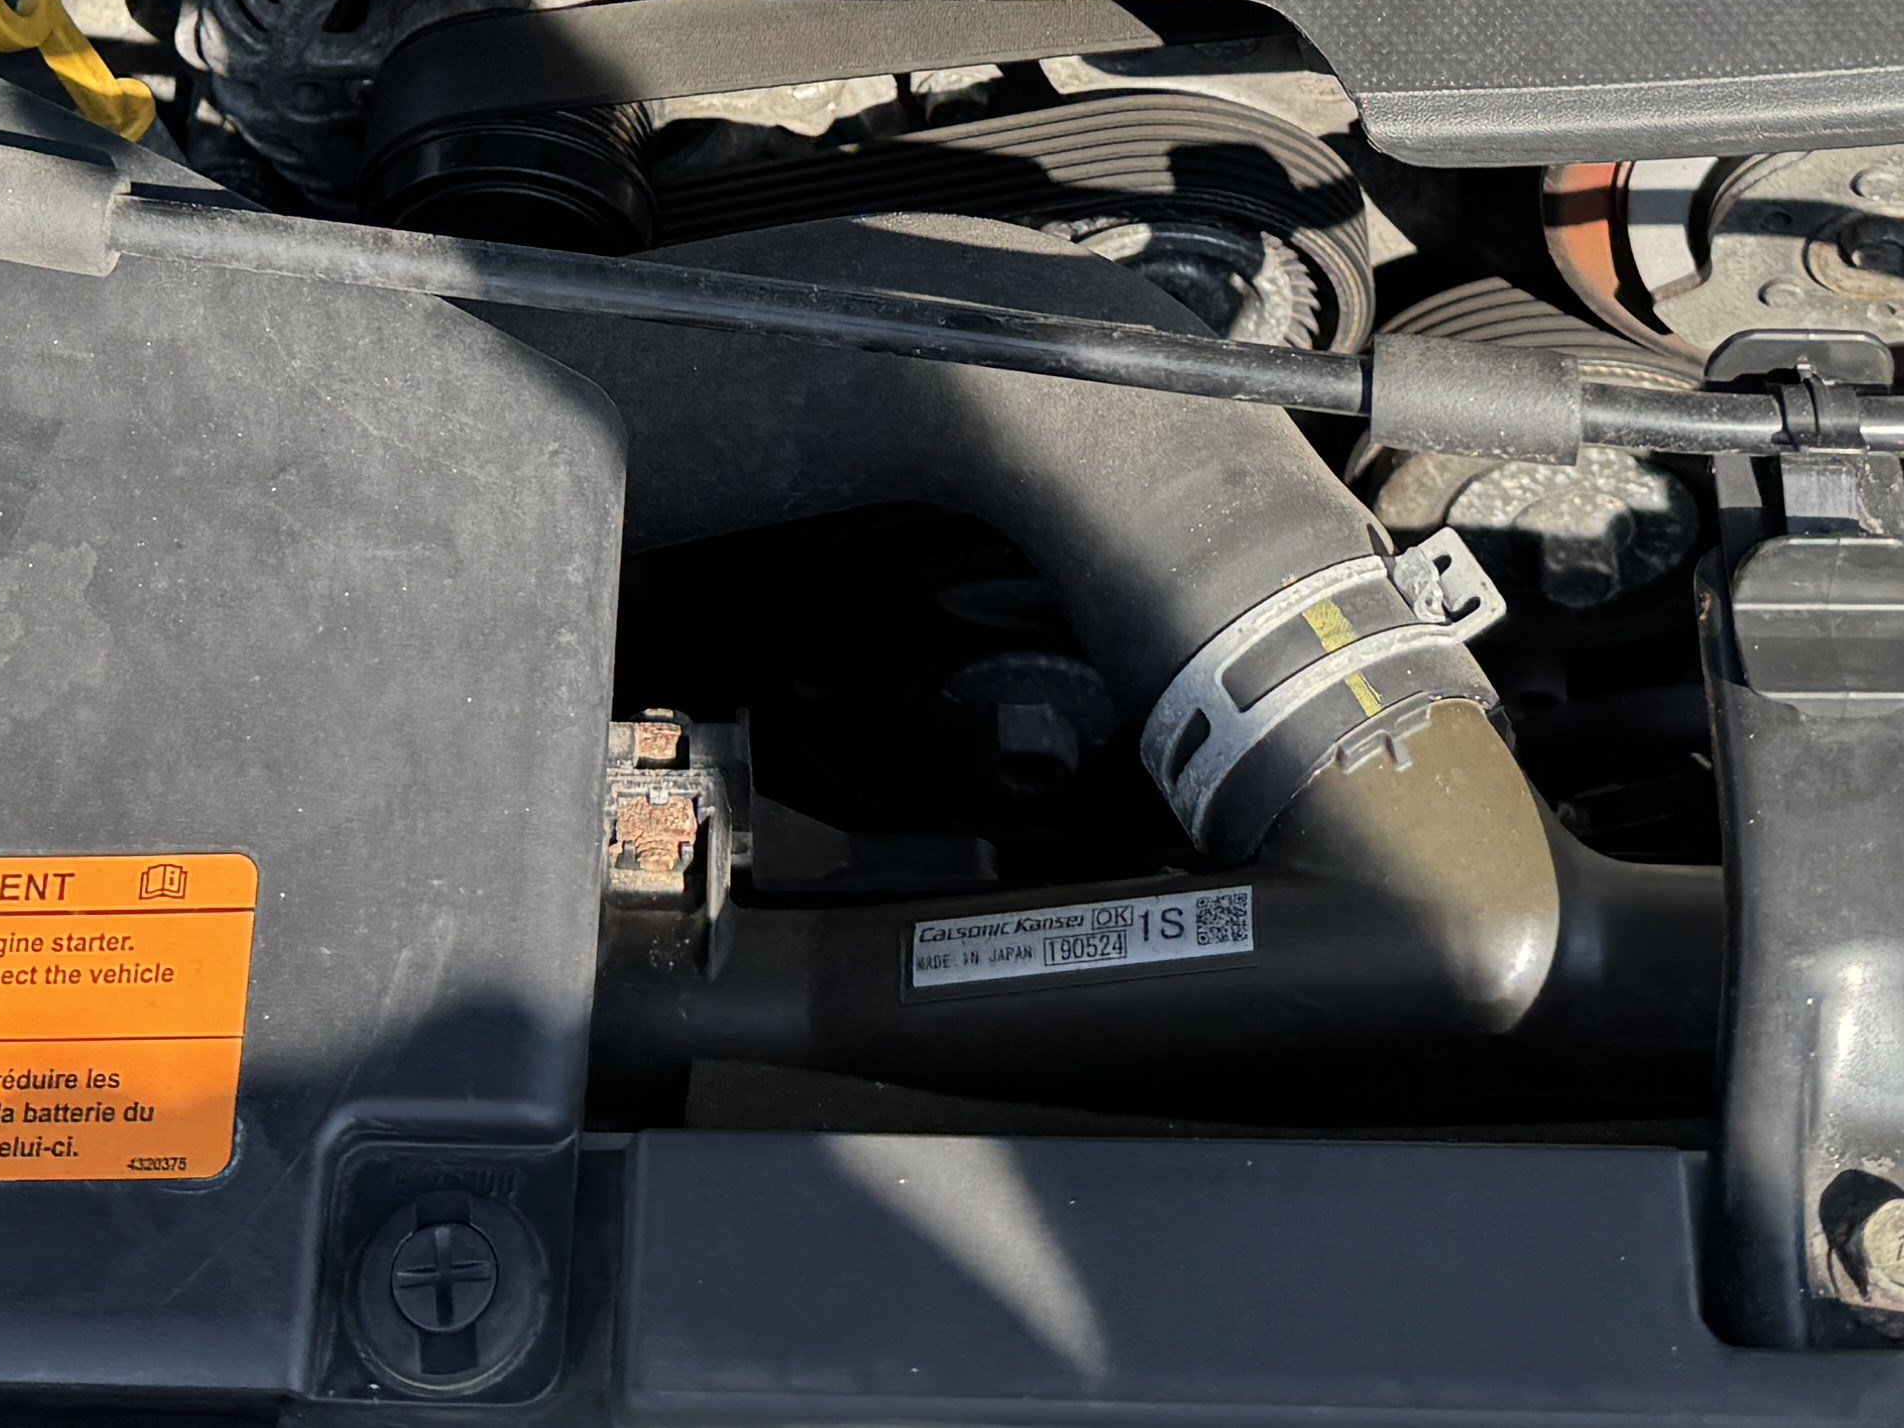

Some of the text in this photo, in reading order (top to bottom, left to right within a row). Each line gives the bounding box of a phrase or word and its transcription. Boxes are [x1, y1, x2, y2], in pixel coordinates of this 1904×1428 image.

[1096, 908, 1129, 927] OK
[51, 932, 136, 952] starter.
[916, 934, 1124, 972] MADE IN JAPAN 190524
[45, 964, 82, 986] the
[89, 962, 176, 985] vehicle
[85, 1067, 121, 1089] les
[22, 1101, 115, 1125] batterie
[123, 1100, 155, 1123] du
